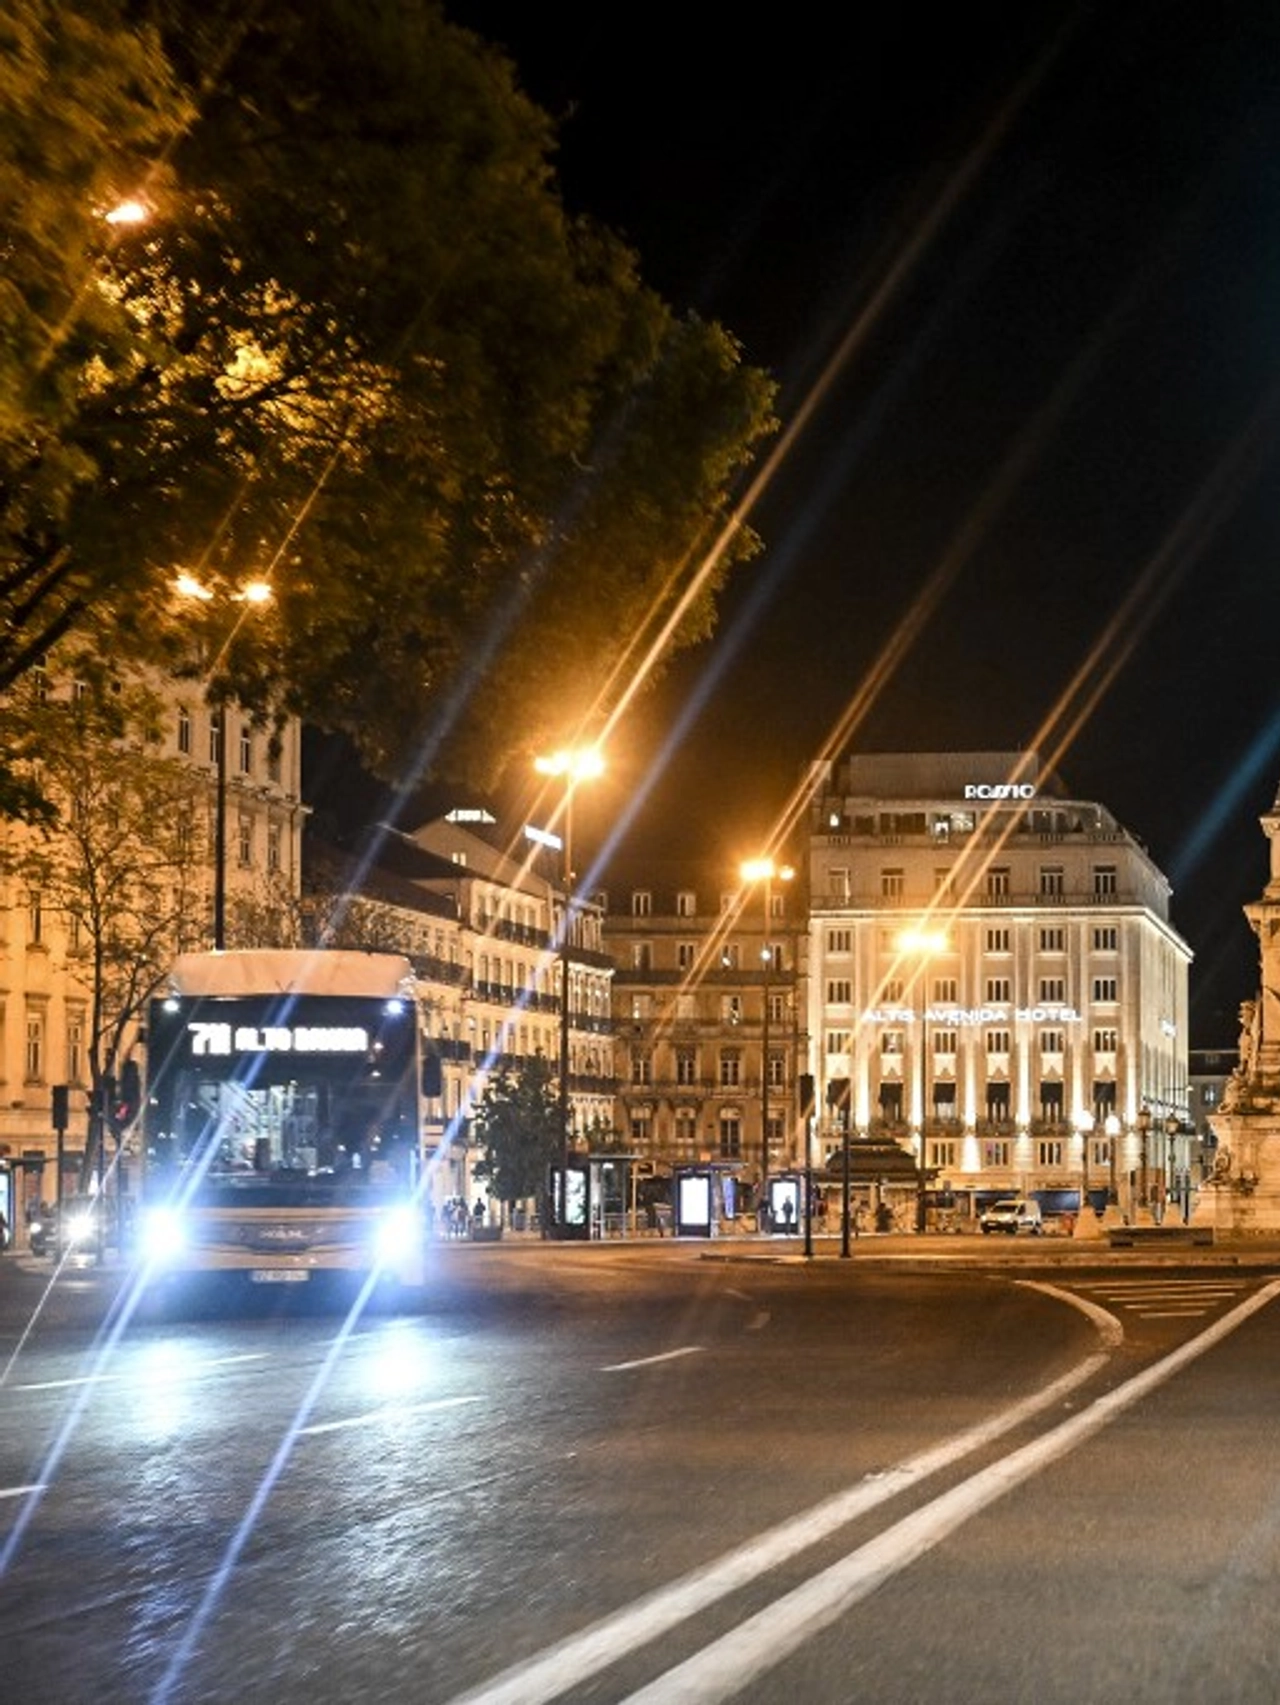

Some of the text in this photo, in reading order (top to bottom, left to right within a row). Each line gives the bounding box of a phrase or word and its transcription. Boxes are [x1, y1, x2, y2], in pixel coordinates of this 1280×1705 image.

[964, 785, 1036, 799] ROSSIO
[924, 1009, 1007, 1022] AVENIDA
[1015, 1009, 1084, 1022] HOTEL
